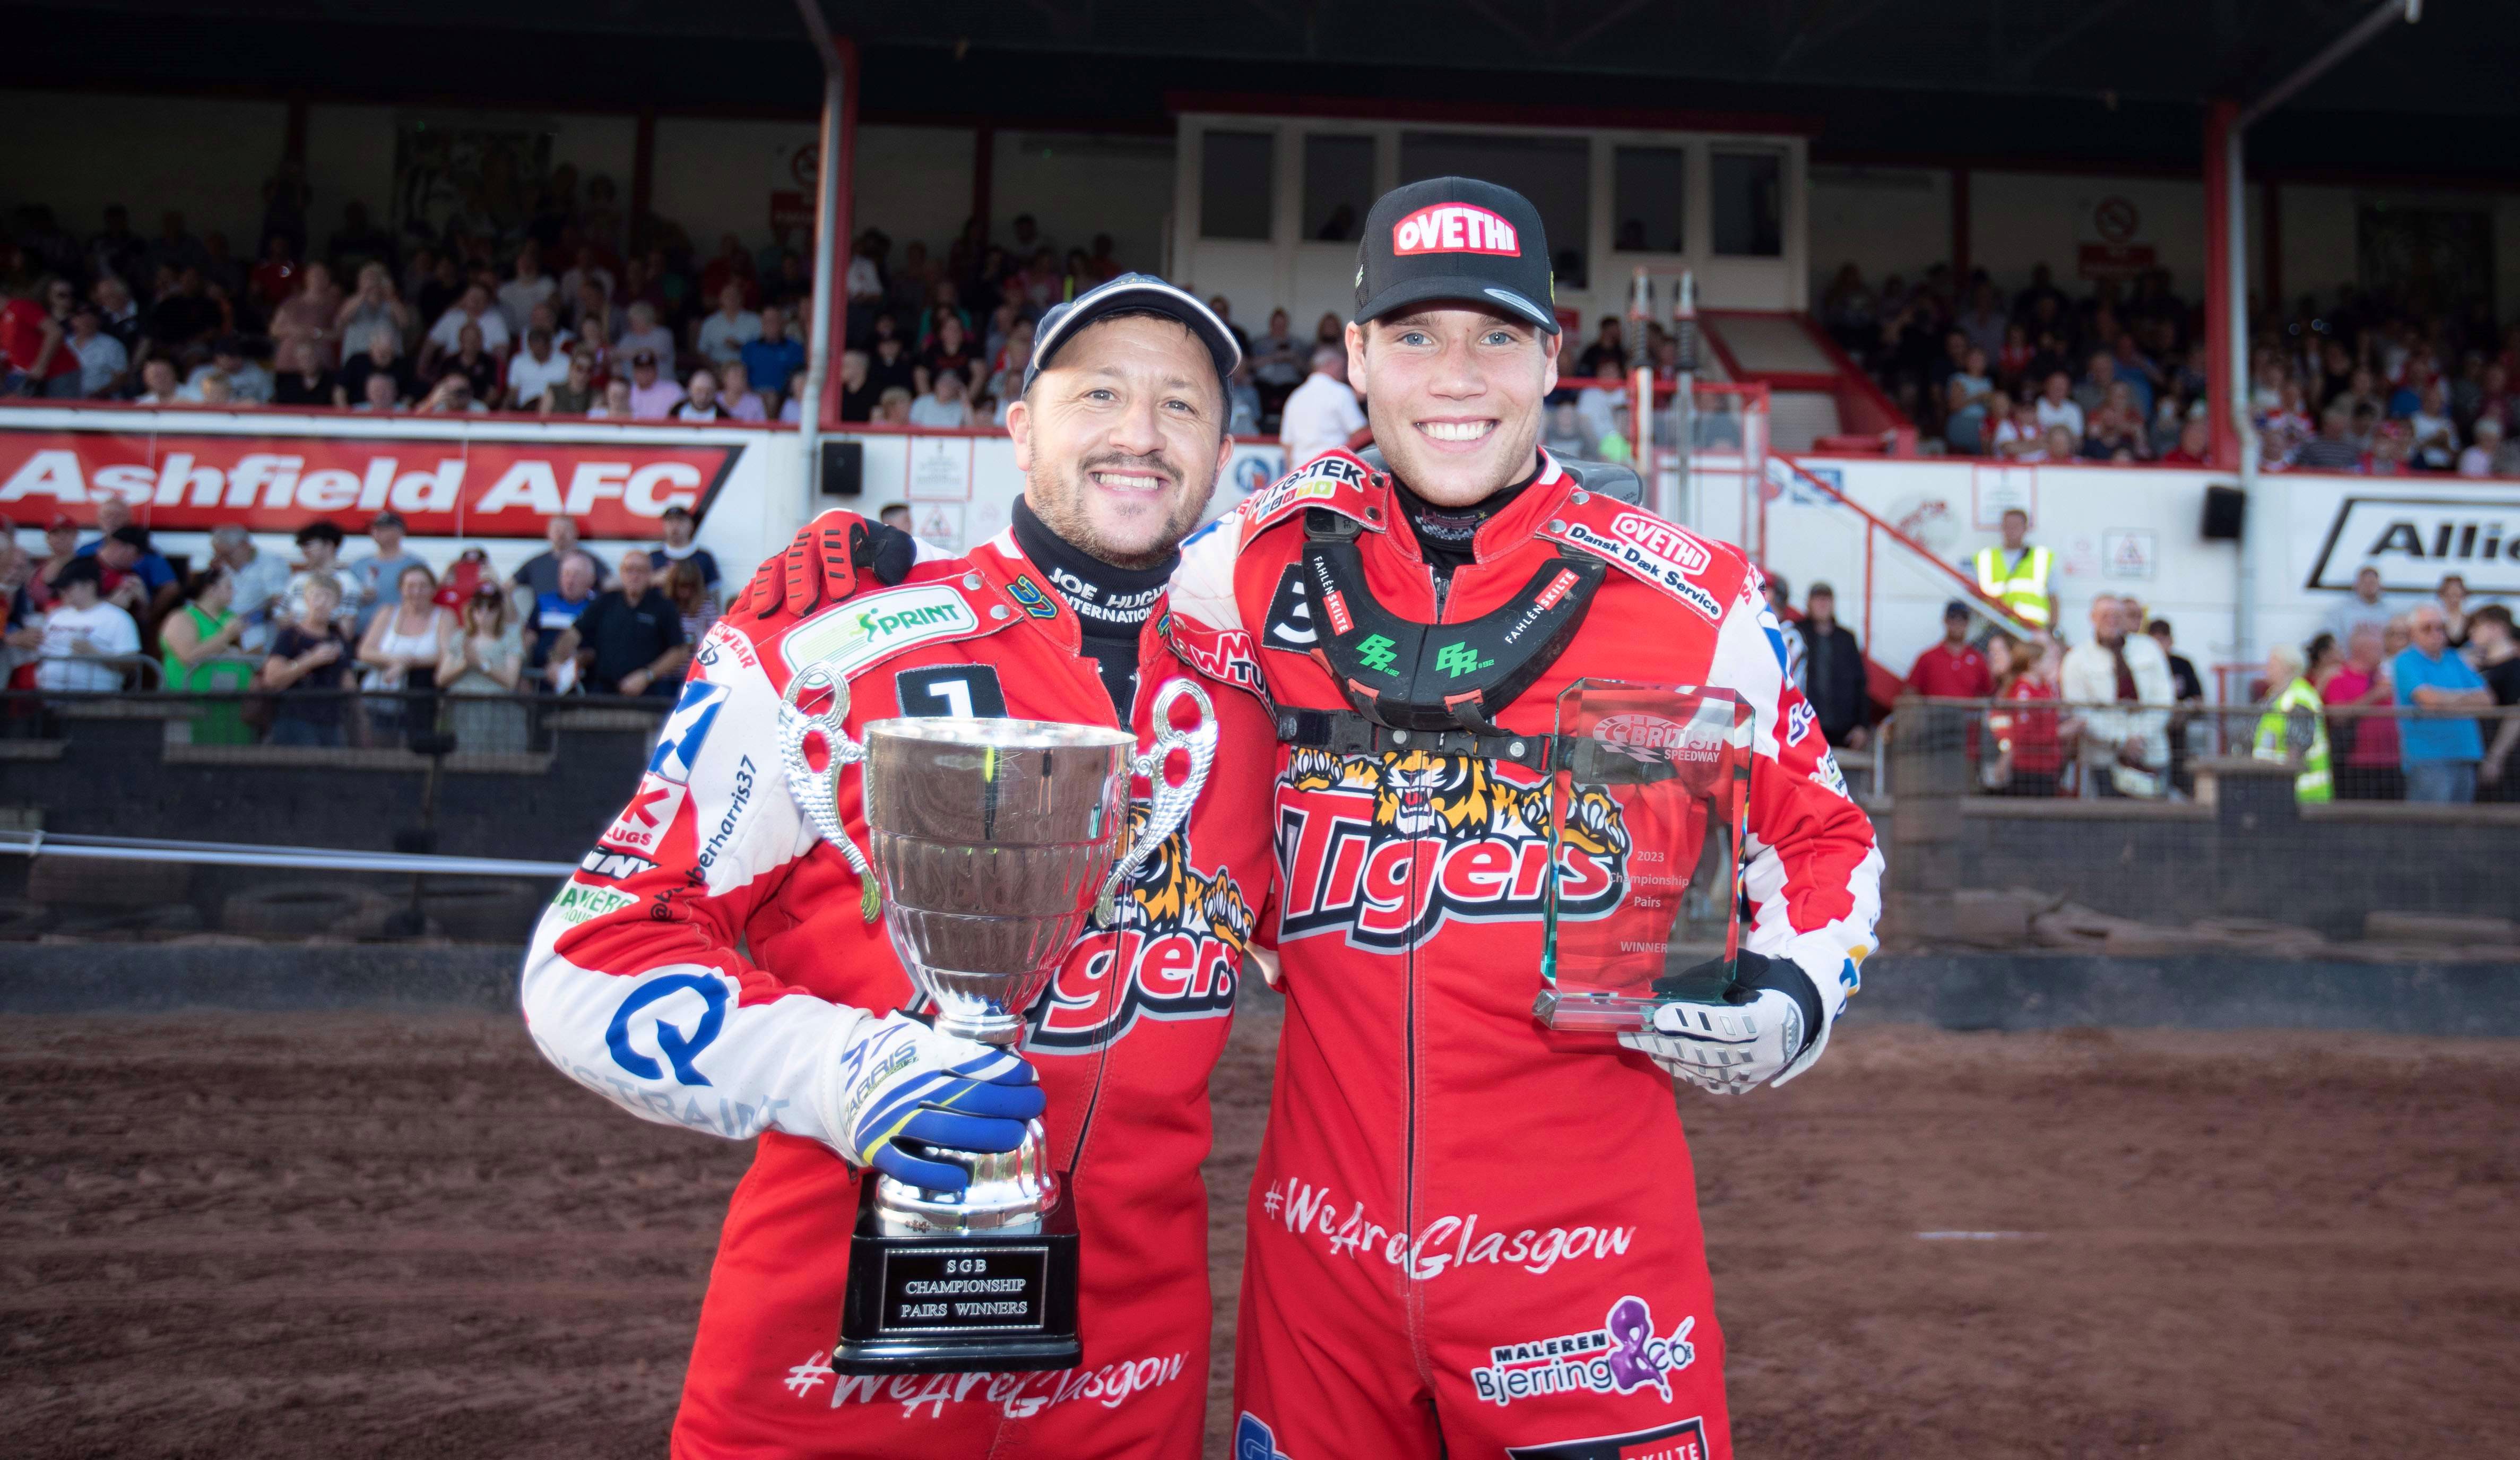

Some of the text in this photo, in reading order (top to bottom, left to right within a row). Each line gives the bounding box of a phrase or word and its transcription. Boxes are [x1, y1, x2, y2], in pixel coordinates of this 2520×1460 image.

[1398, 206, 1516, 250] OVETHI
[1, 448, 703, 519] Ashfield AFC
[1620, 519, 1703, 568] OVETHI
[1048, 567, 1098, 601] JOE
[1570, 526, 1620, 555] Dansk
[1623, 547, 1661, 577] Dæk
[1664, 571, 1719, 616] Service
[1629, 725, 1725, 751] BRITISH
[1664, 748, 1720, 763] SPEEDWAY
[1274, 789, 1615, 933] Tigers
[1636, 851, 1665, 862] 2023
[1609, 872, 1690, 889] Championship
[1633, 895, 1661, 908] Pairs
[1620, 940, 1669, 954] WINNER
[1264, 1176, 1637, 1280] #WeAreGlasgow
[905, 1279, 1026, 1294] CHAMPIONSHIP
[900, 1301, 1028, 1317] PAIRS WINNERS
[1495, 1332, 1607, 1362] MALEREN
